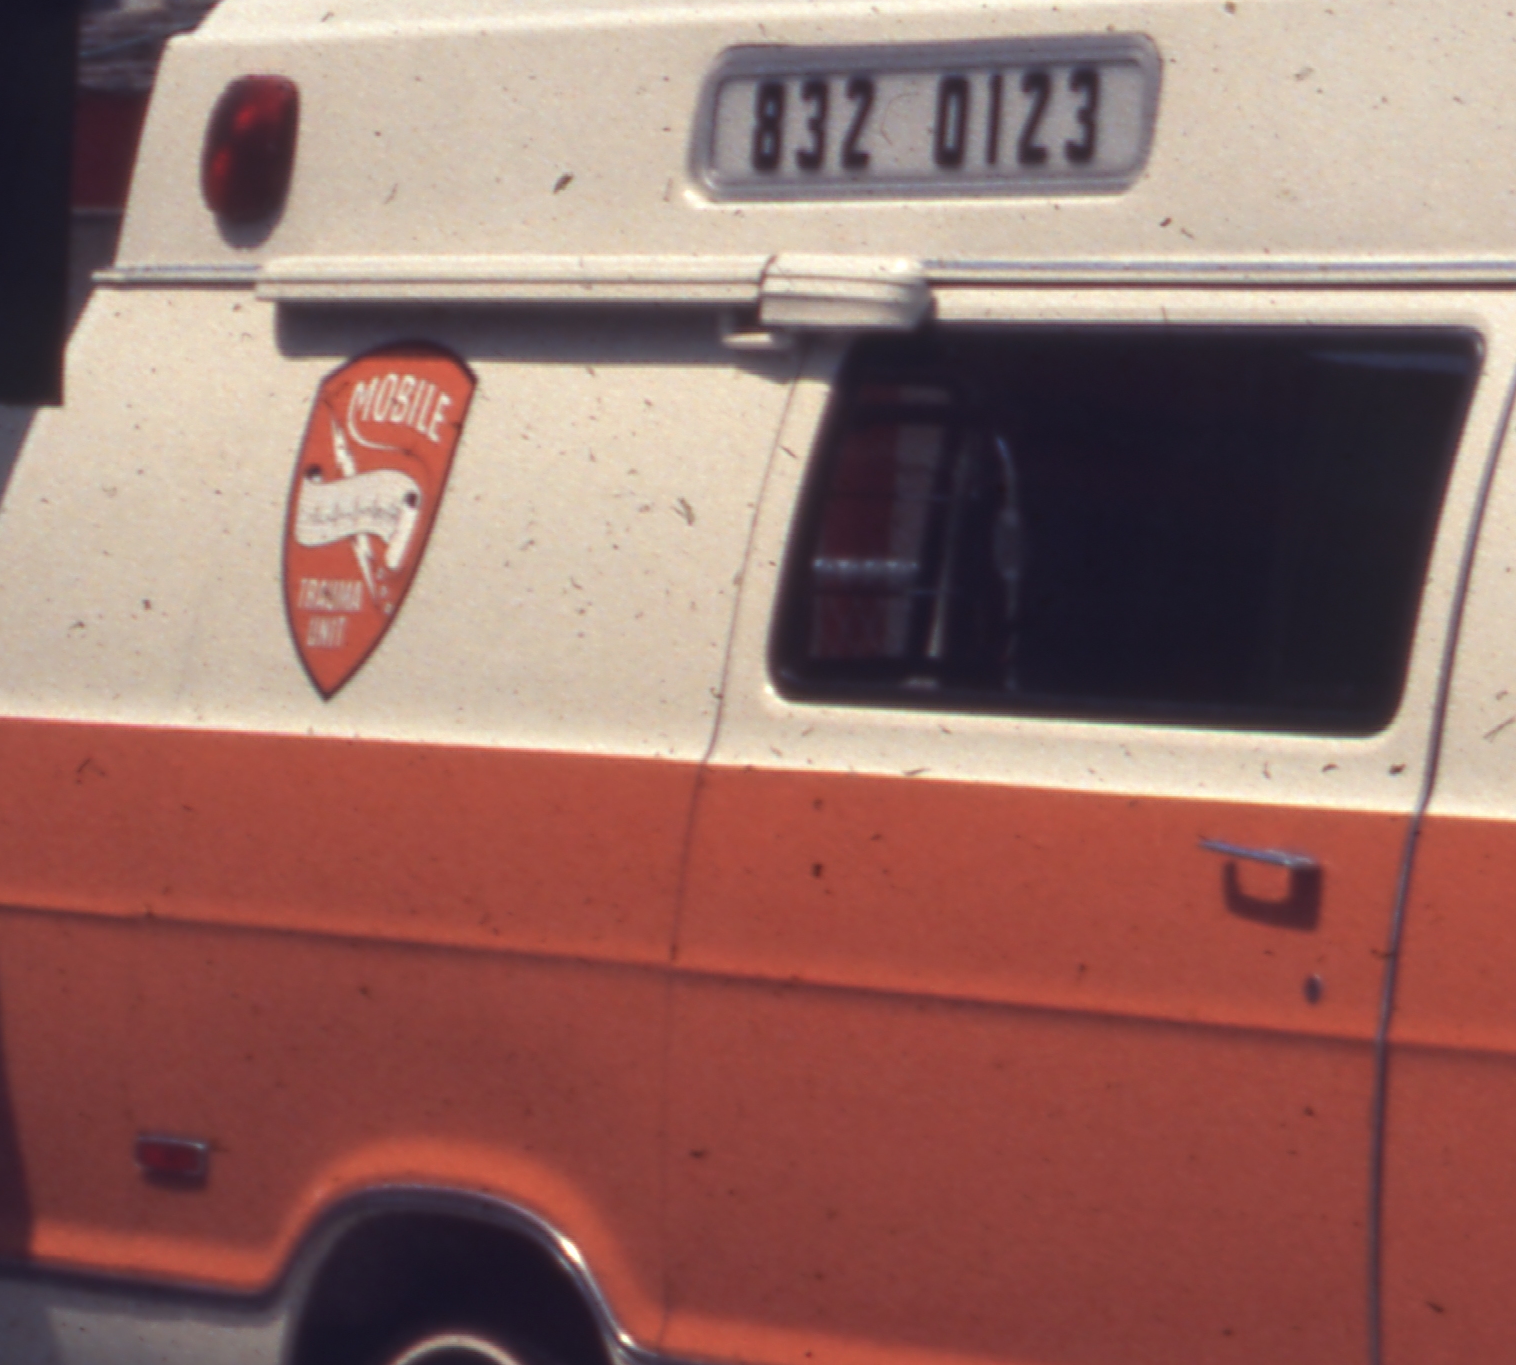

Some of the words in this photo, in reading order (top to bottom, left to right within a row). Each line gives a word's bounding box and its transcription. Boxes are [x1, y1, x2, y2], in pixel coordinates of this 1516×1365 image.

[751, 76, 874, 174] 832
[933, 65, 1100, 170] 0123
[347, 372, 452, 451] MOBILE
